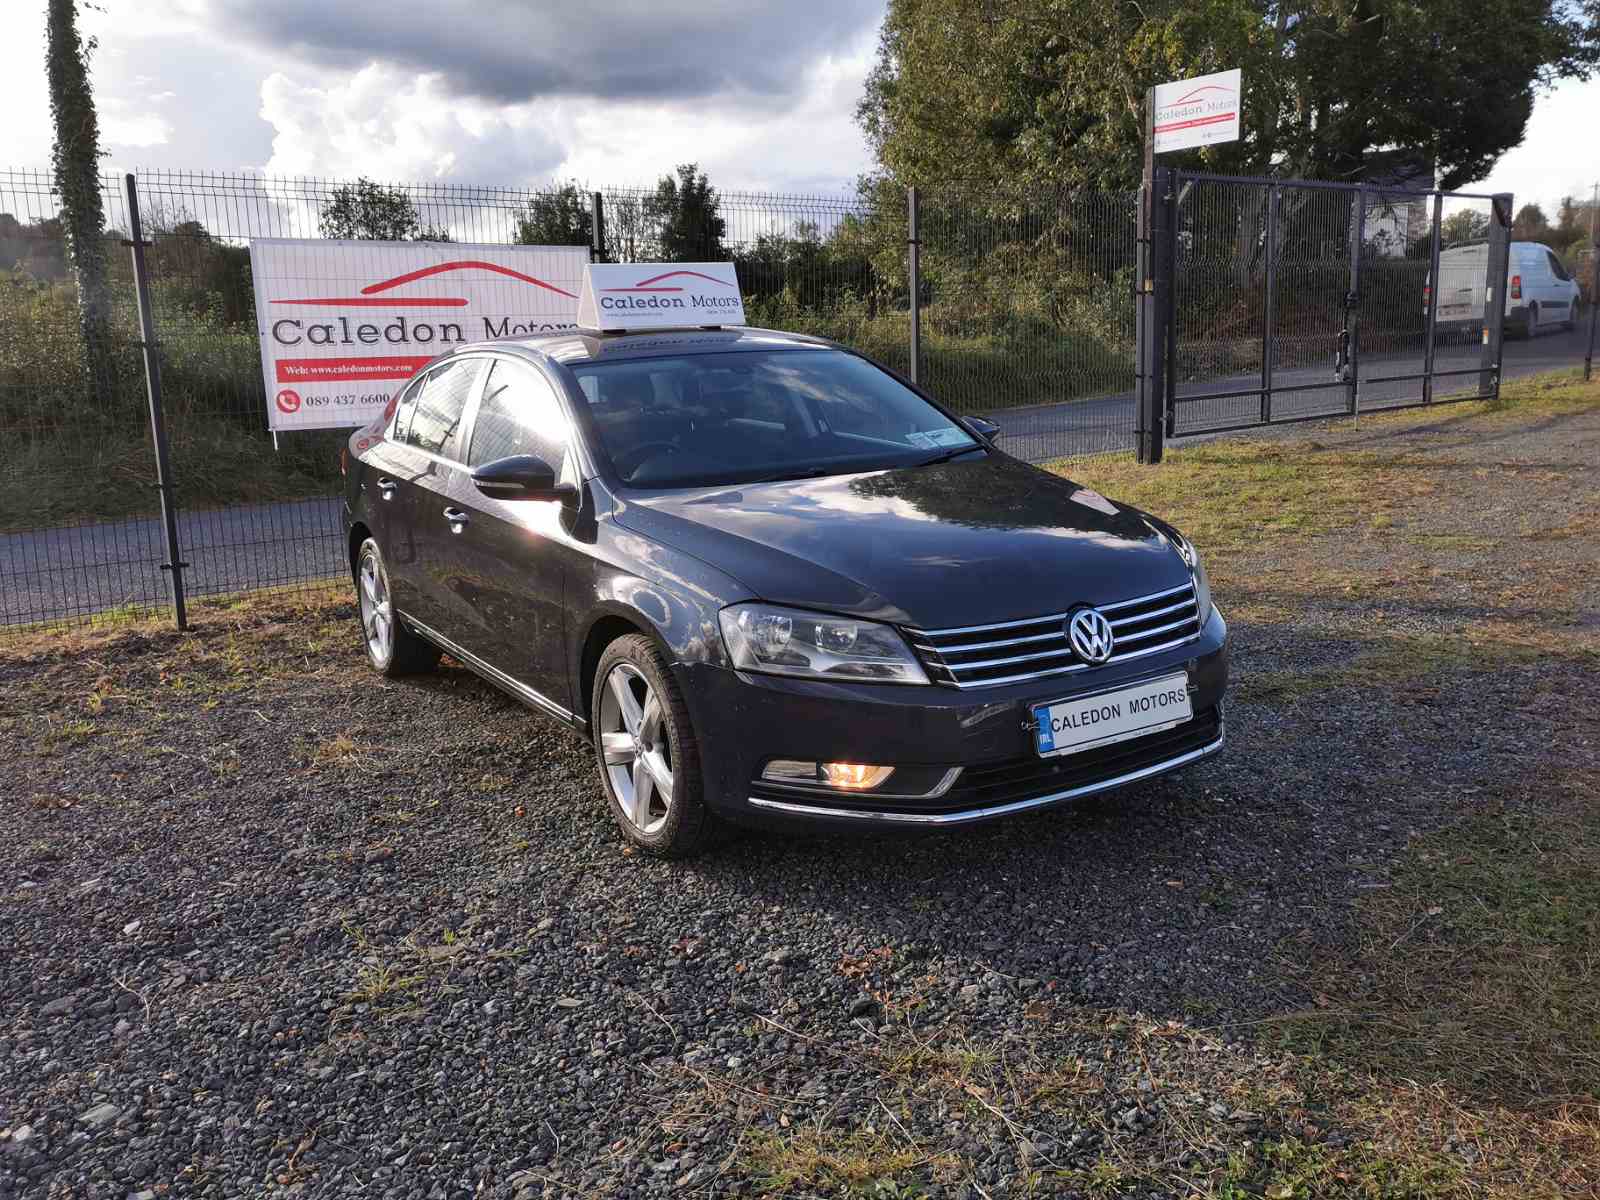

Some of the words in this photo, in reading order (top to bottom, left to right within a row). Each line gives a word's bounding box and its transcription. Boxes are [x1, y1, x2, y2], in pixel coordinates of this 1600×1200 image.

[600, 296, 685, 310] Caledon
[691, 295, 740, 308] Motors
[272, 317, 466, 345] Caledon
[285, 366, 309, 375] Web:
[311, 364, 413, 375] www.caledonmotors.com
[305, 395, 330, 407] 089
[334, 394, 356, 406] 437
[360, 393, 391, 405] 6600
[1051, 704, 1122, 733] CALEDON
[1129, 688, 1186, 715] MOTORS
